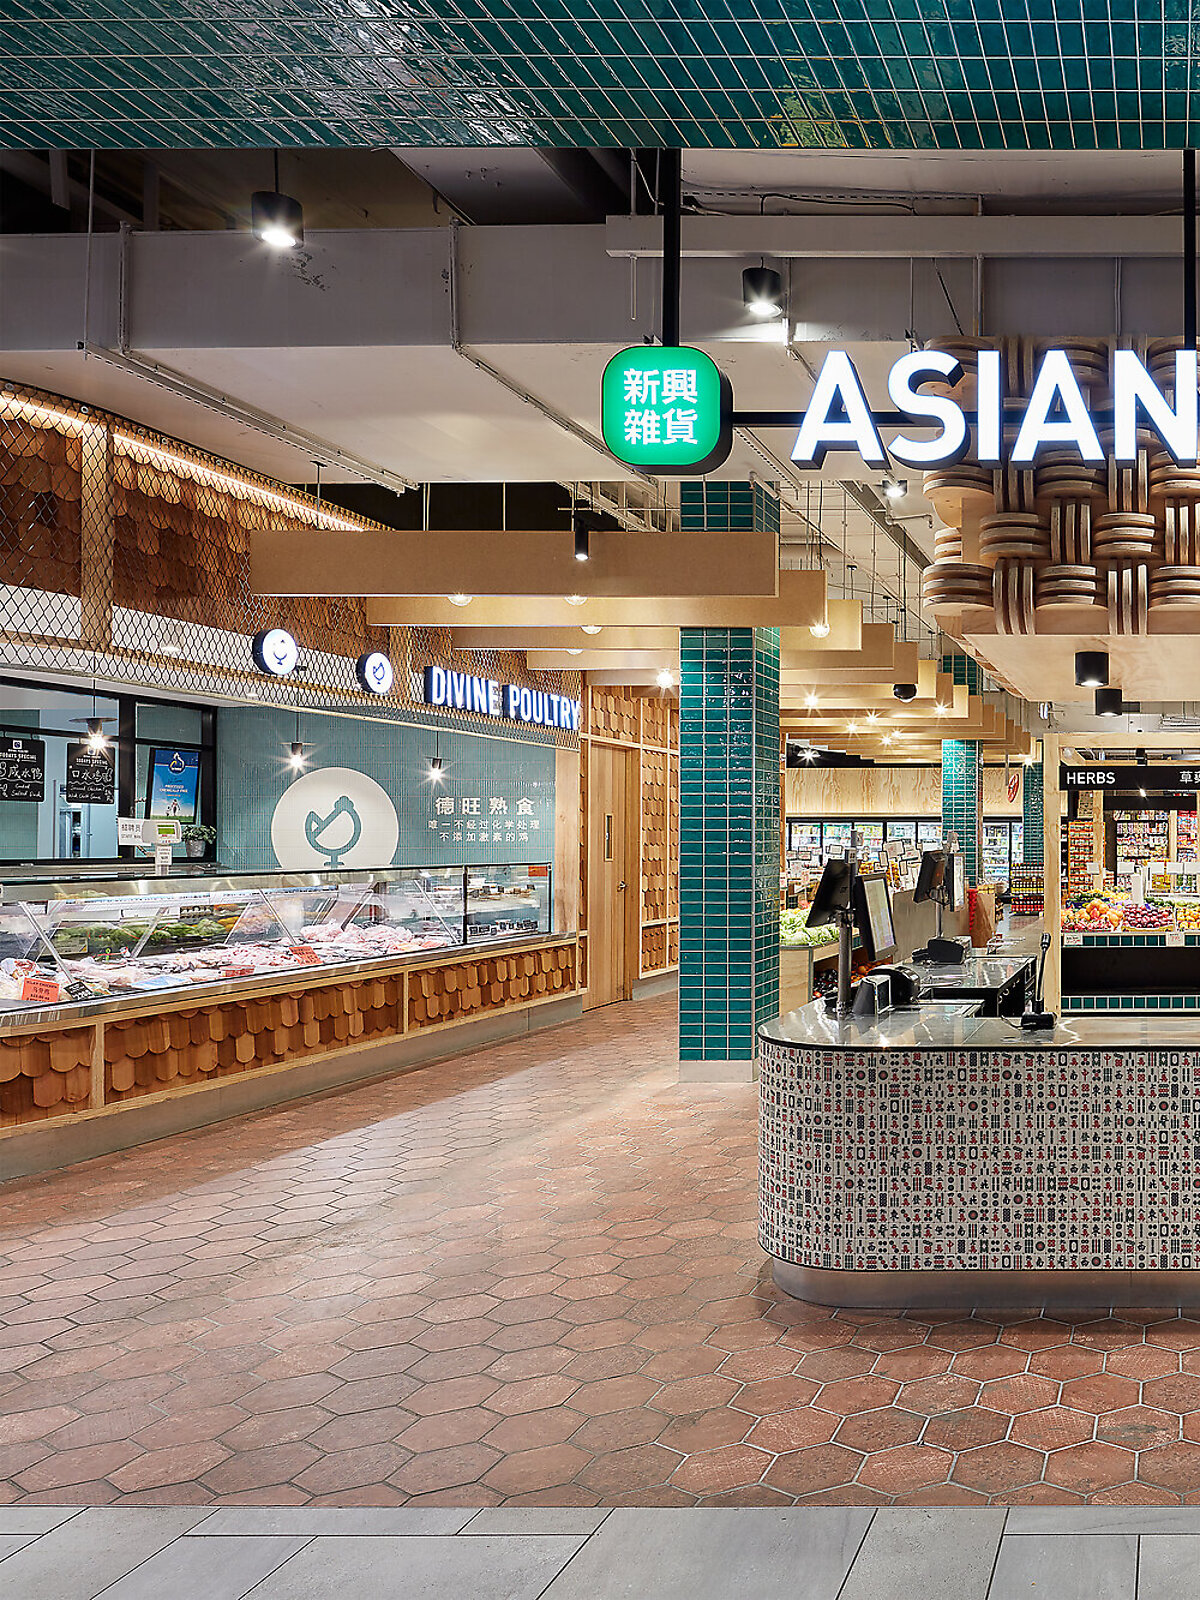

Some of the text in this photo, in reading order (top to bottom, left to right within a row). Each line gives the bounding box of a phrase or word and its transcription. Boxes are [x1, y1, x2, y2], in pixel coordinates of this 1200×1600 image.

[623, 368, 698, 405] 新興
[791, 349, 1198, 462] ASIAN
[623, 408, 698, 446] 雜貨
[431, 666, 580, 731] DIVINE POULTRY
[1066, 771, 1116, 785] HERBS
[435, 797, 534, 816] 德旺熟食
